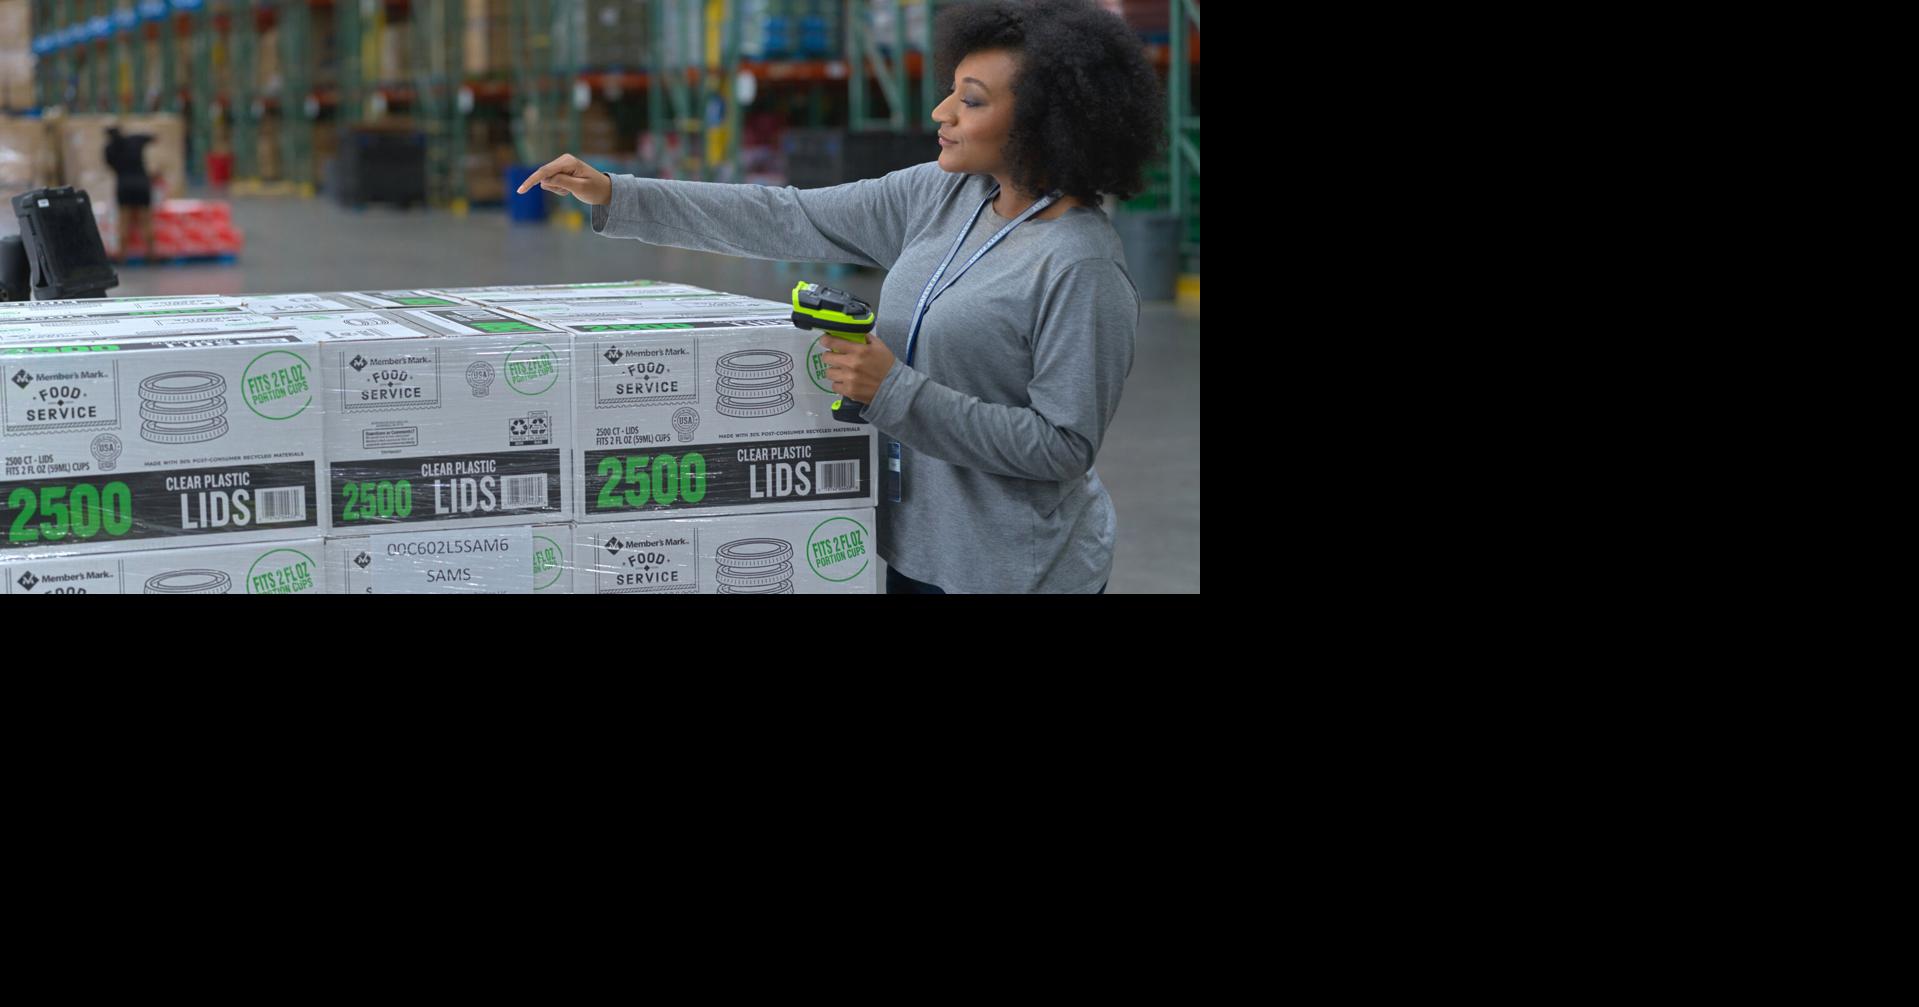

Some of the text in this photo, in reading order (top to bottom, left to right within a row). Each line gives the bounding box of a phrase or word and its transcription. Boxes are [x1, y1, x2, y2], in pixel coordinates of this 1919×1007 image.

[625, 349, 664, 358] Member's
[370, 358, 407, 366] Member's
[628, 362, 665, 376] FOOD
[36, 371, 79, 381] Member's
[248, 374, 271, 394] FITS
[271, 371, 280, 387] 2
[372, 369, 408, 383] FOOD
[39, 386, 81, 402] FOOD
[252, 381, 309, 405] PORTION CUPS
[361, 387, 421, 400] SERVICE
[616, 381, 678, 395] SERVICE
[26, 406, 97, 421] SERVICE
[596, 427, 611, 437] 2500
[612, 427, 620, 435] CT
[625, 426, 639, 435] LIDS
[596, 437, 609, 446] FITS
[610, 436, 615, 445] 2
[615, 436, 622, 445] FL
[623, 435, 632, 444] OZ
[655, 433, 671, 442] CUPS
[5, 456, 22, 466] 2500
[24, 455, 32, 465] CT
[38, 454, 54, 464] LIDS
[737, 445, 812, 462] CLEAR PLASTIC
[5, 466, 20, 476] FITS
[21, 466, 26, 475] 2
[27, 465, 35, 475] FL
[36, 464, 46, 474] OZ
[72, 461, 90, 472] CUPS
[421, 459, 496, 477] CLEAR PLASTIC
[166, 472, 250, 491] CLEAR PLASTIC
[596, 452, 707, 508] 2500
[750, 461, 811, 498] LIDS
[343, 479, 412, 521] 2500
[434, 476, 497, 514] LIDS
[8, 481, 133, 542] 2500
[181, 488, 251, 529] LIDS
[625, 540, 664, 549] Member's
[812, 530, 863, 558] FITS 2 FL OZ
[628, 552, 665, 567] FOOD
[816, 545, 866, 568] PORTION CUPS
[41, 573, 85, 583] Member's
[253, 571, 276, 593] FITS
[276, 569, 285, 585] 2
[427, 568, 471, 583] SAMS
[616, 571, 678, 585] SERVICE
[292, 577, 313, 592] CUPS
